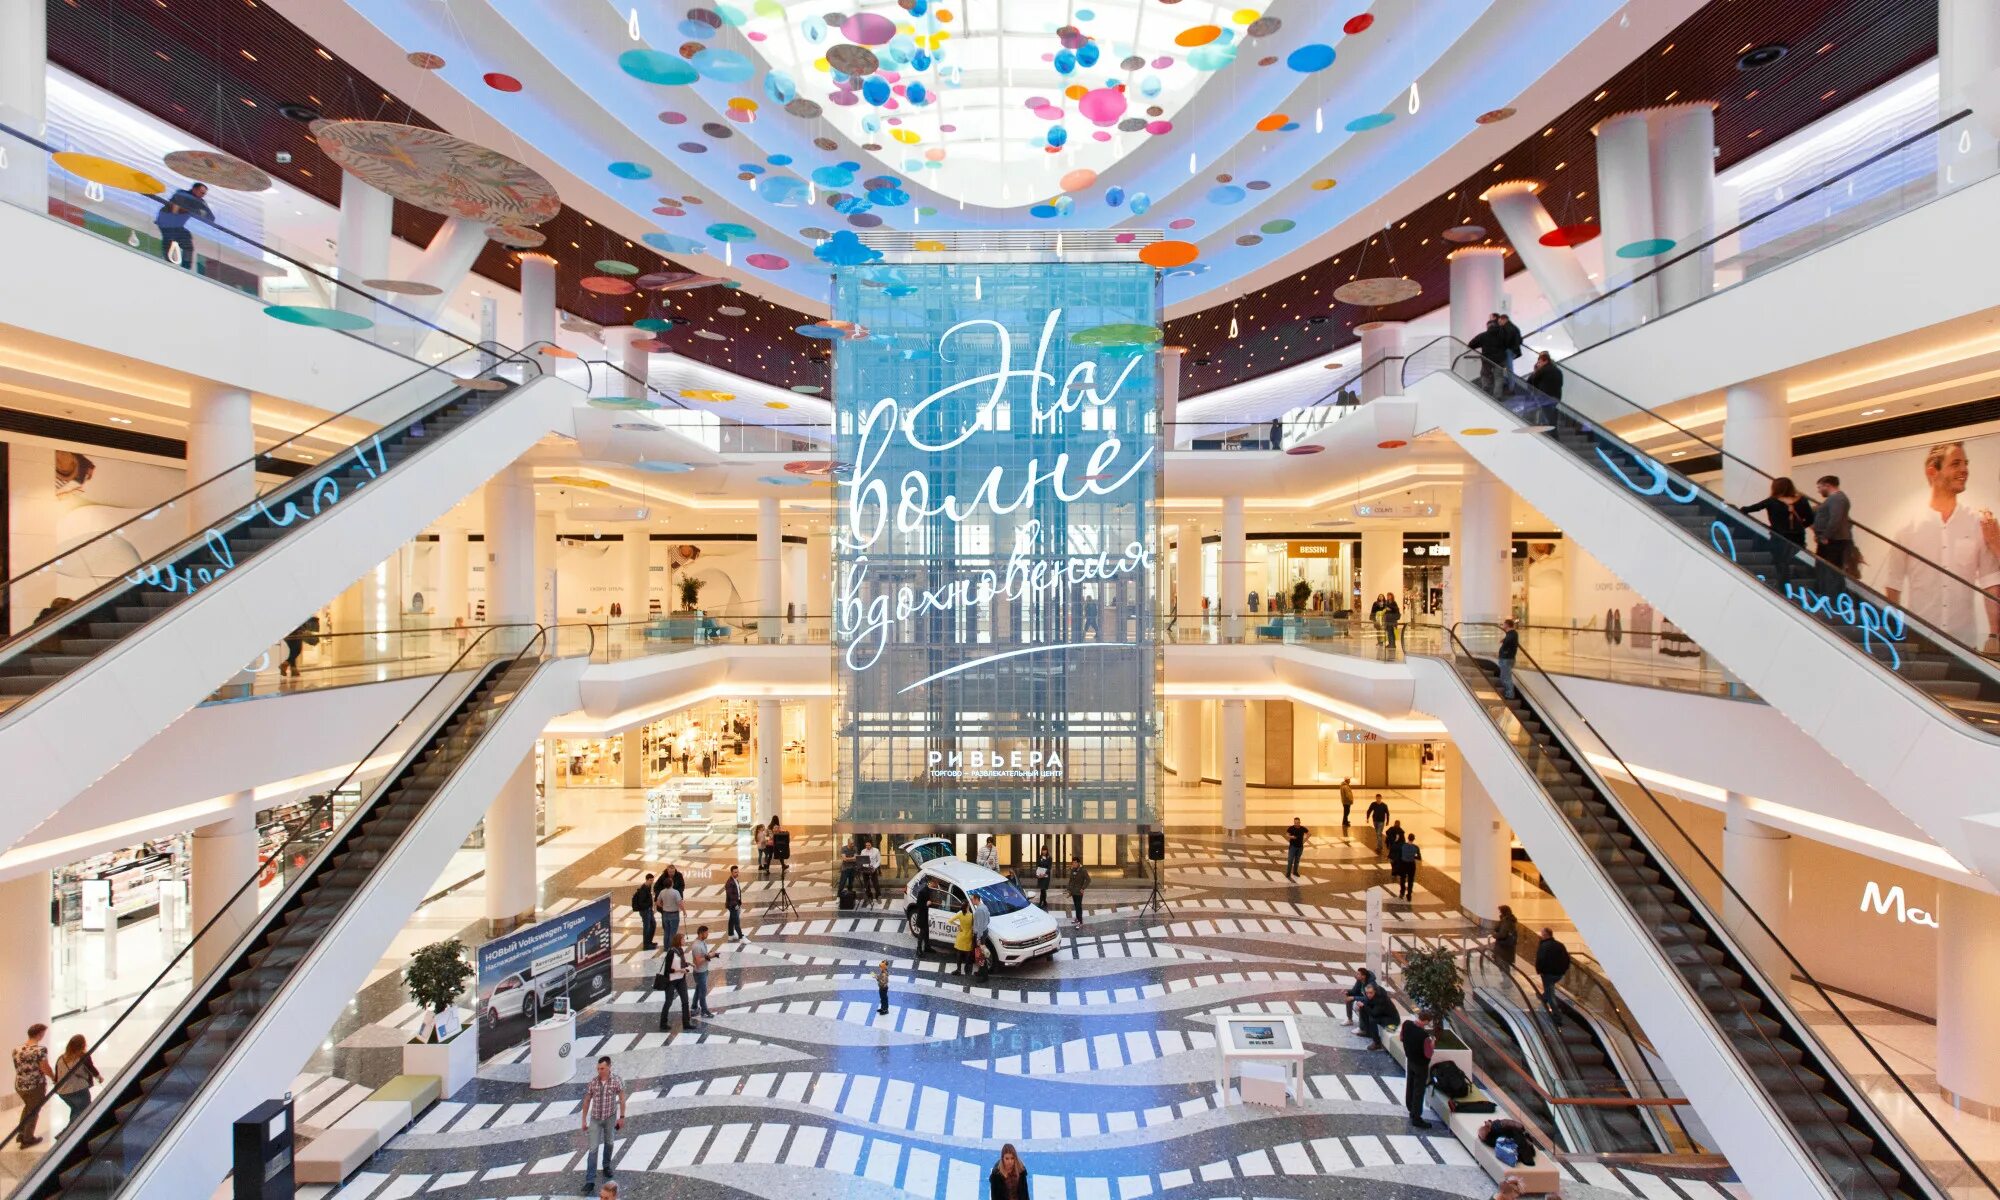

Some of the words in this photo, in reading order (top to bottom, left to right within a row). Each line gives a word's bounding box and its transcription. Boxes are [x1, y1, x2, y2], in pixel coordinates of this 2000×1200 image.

[905, 307, 1144, 452] На
[838, 397, 1155, 550] волне
[1299, 546, 1328, 554] BESSINI
[837, 519, 1155, 672] вдохновения
[928, 750, 1063, 768] РИВЬЕРА
[930, 770, 963, 778] ТОРГОВО
[971, 769, 1039, 778] РАЗВЛЕКАТЕЛЬНЫЙ
[1041, 770, 1064, 779] ЦЕНТР
[485, 940, 518, 962] НОВЫЙ
[518, 925, 563, 949] Volkswagen
[562, 915, 586, 931] Tiguan
